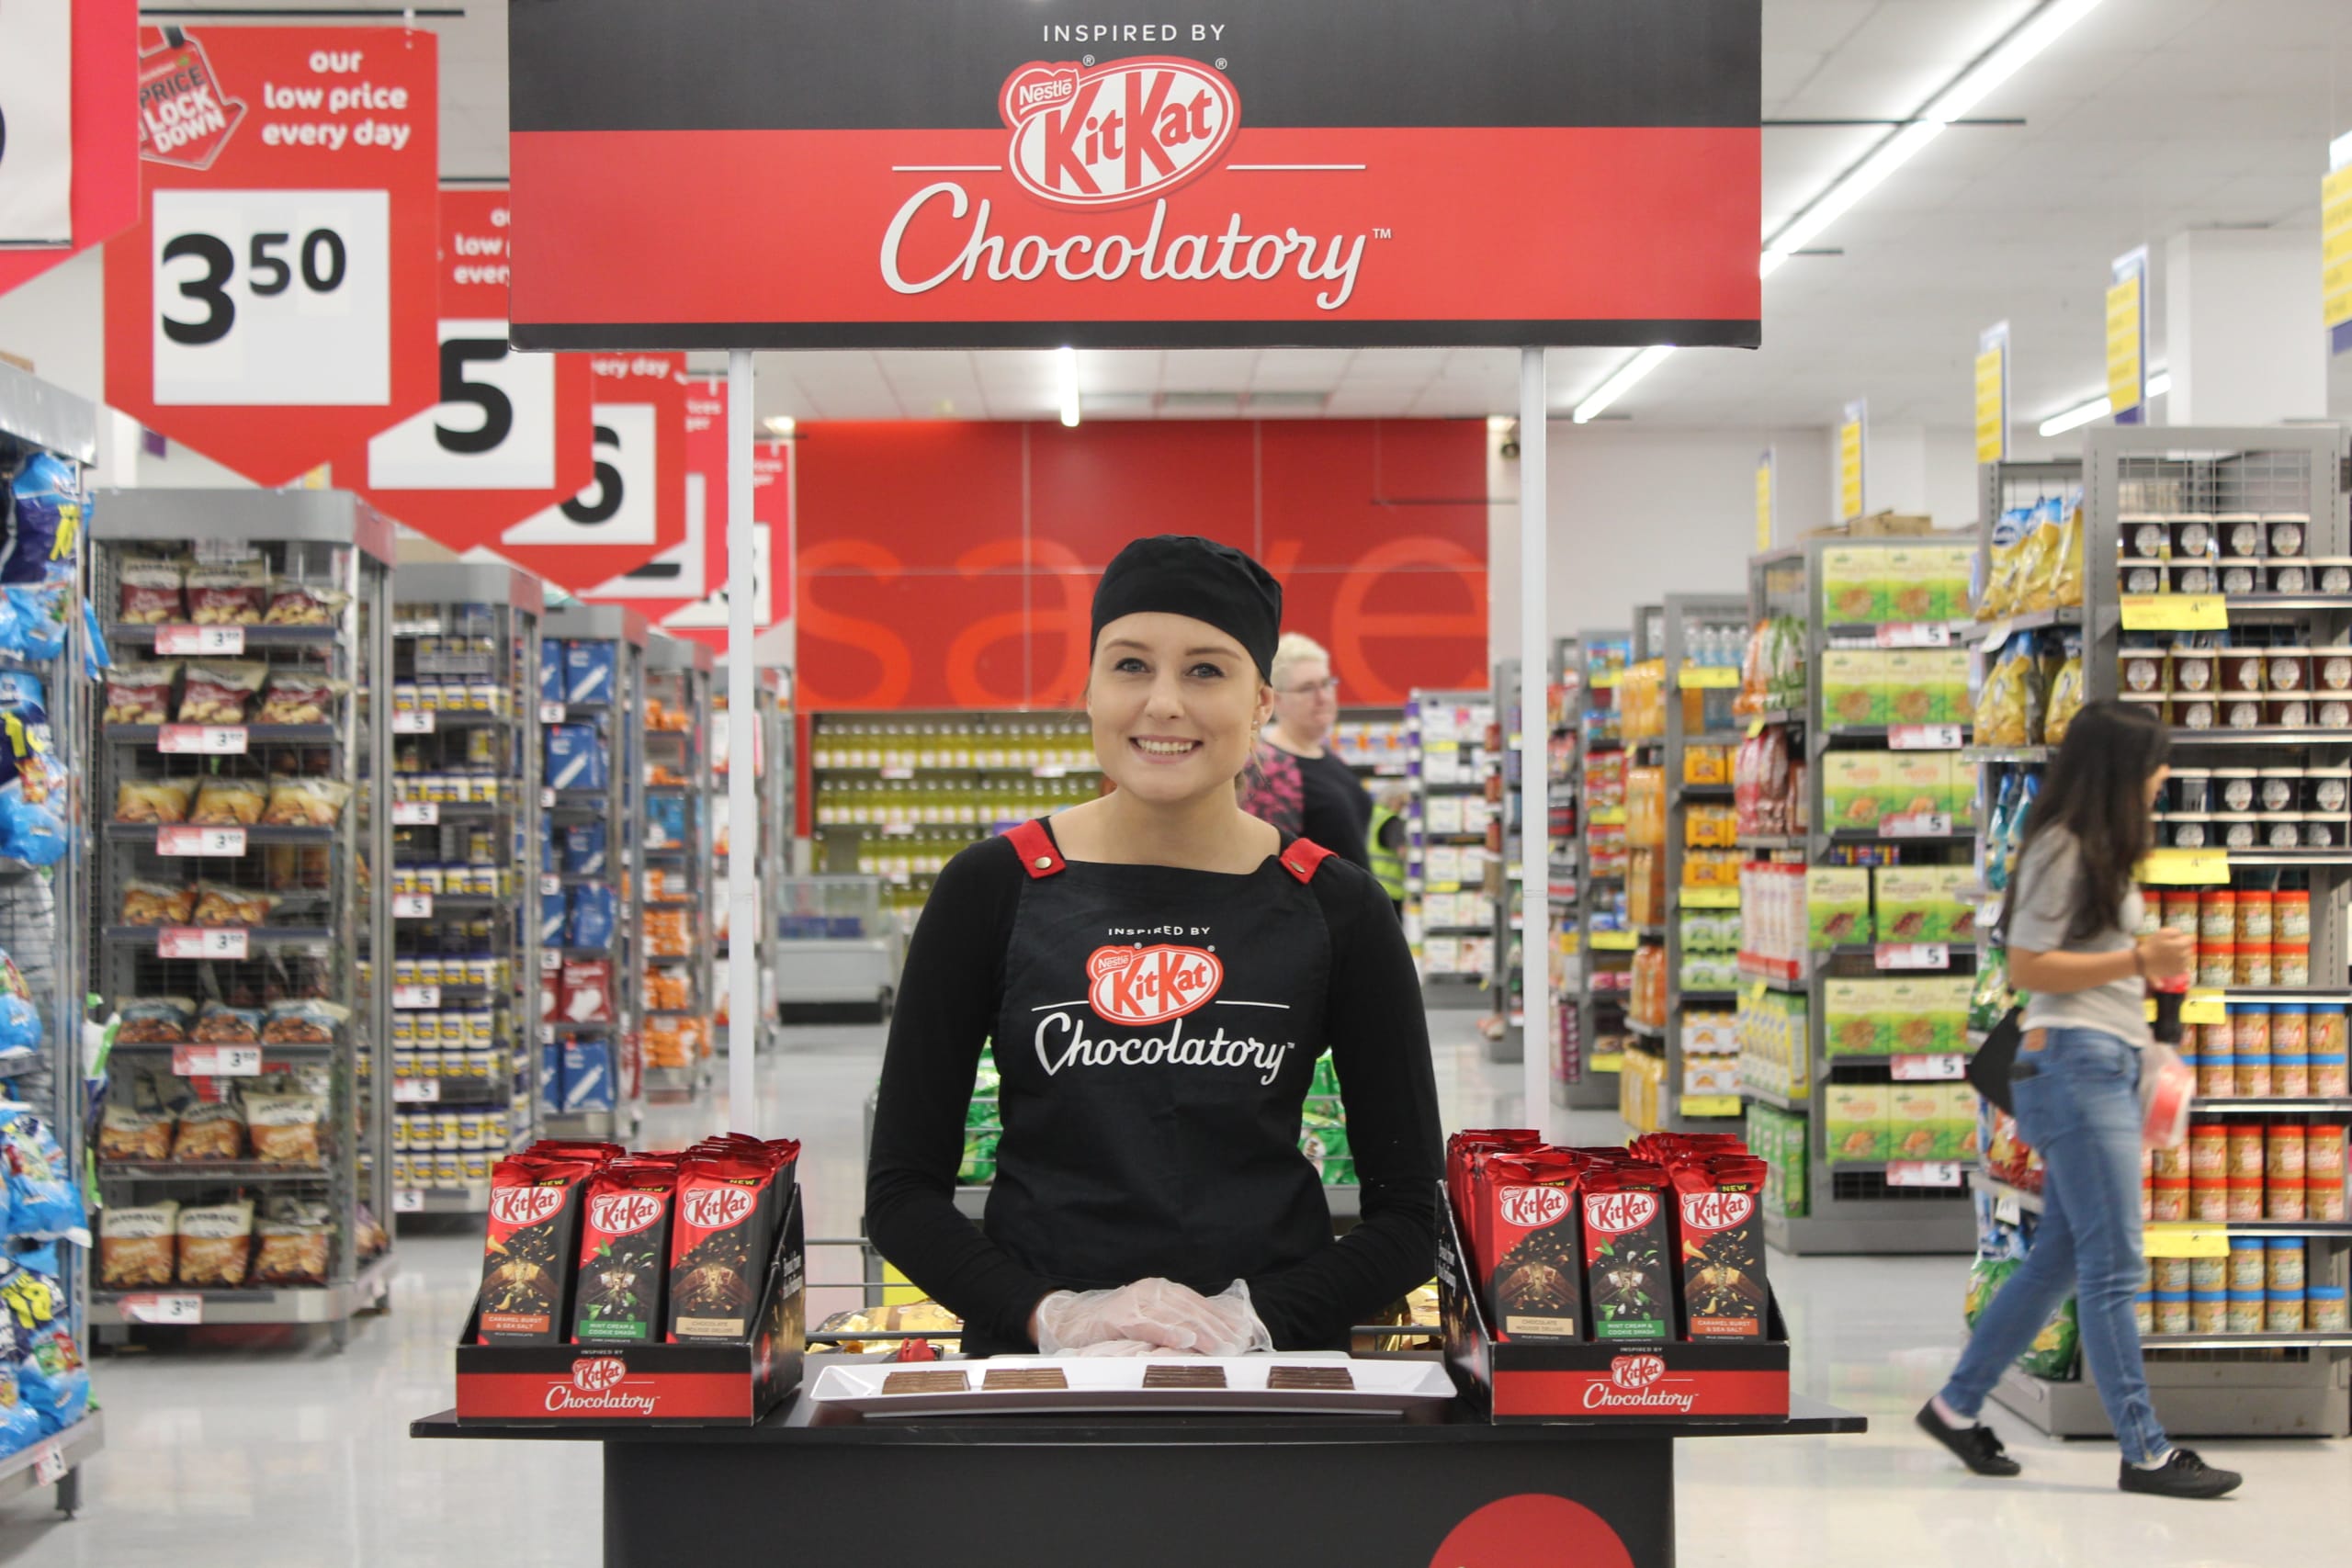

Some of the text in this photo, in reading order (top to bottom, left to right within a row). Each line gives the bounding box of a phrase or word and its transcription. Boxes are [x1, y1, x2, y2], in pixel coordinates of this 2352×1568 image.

[1043, 24, 1227, 42] INSPIRED BY
[309, 51, 364, 73] our
[140, 64, 207, 109] PRICE
[263, 81, 409, 114] low price
[1019, 77, 1074, 106] Nestlé
[143, 84, 216, 133] LOCK
[153, 108, 227, 154] DOWN
[261, 118, 411, 151] every day
[1044, 71, 1214, 194] KitKat
[454, 231, 503, 256] low
[879, 181, 1367, 310] Chocolatory
[453, 263, 511, 288] ever
[631, 355, 671, 379] day
[435, 338, 513, 454] 5
[797, 536, 1488, 709] sae
[1928, 627, 1939, 643] 5
[1940, 729, 1952, 746] 5
[1929, 817, 1942, 832] 5
[1108, 926, 1211, 936] INSPIRED BY
[1927, 949, 1939, 964] 5
[1113, 952, 1207, 1016] KitKat
[1035, 1011, 1286, 1086] Chocolatory
[1943, 1058, 1955, 1074] 5
[1939, 1166, 1951, 1181] 5
[502, 1187, 555, 1222] KitKat
[602, 1196, 655, 1231] KitKat
[695, 1190, 747, 1224] KitKat
[1511, 1189, 1562, 1223] KitKat
[1598, 1194, 1648, 1229] KitKat
[1694, 1192, 1745, 1226] KitKat
[545, 1385, 655, 1415] Chocolatory
[1583, 1382, 1693, 1412] Chocolatory
